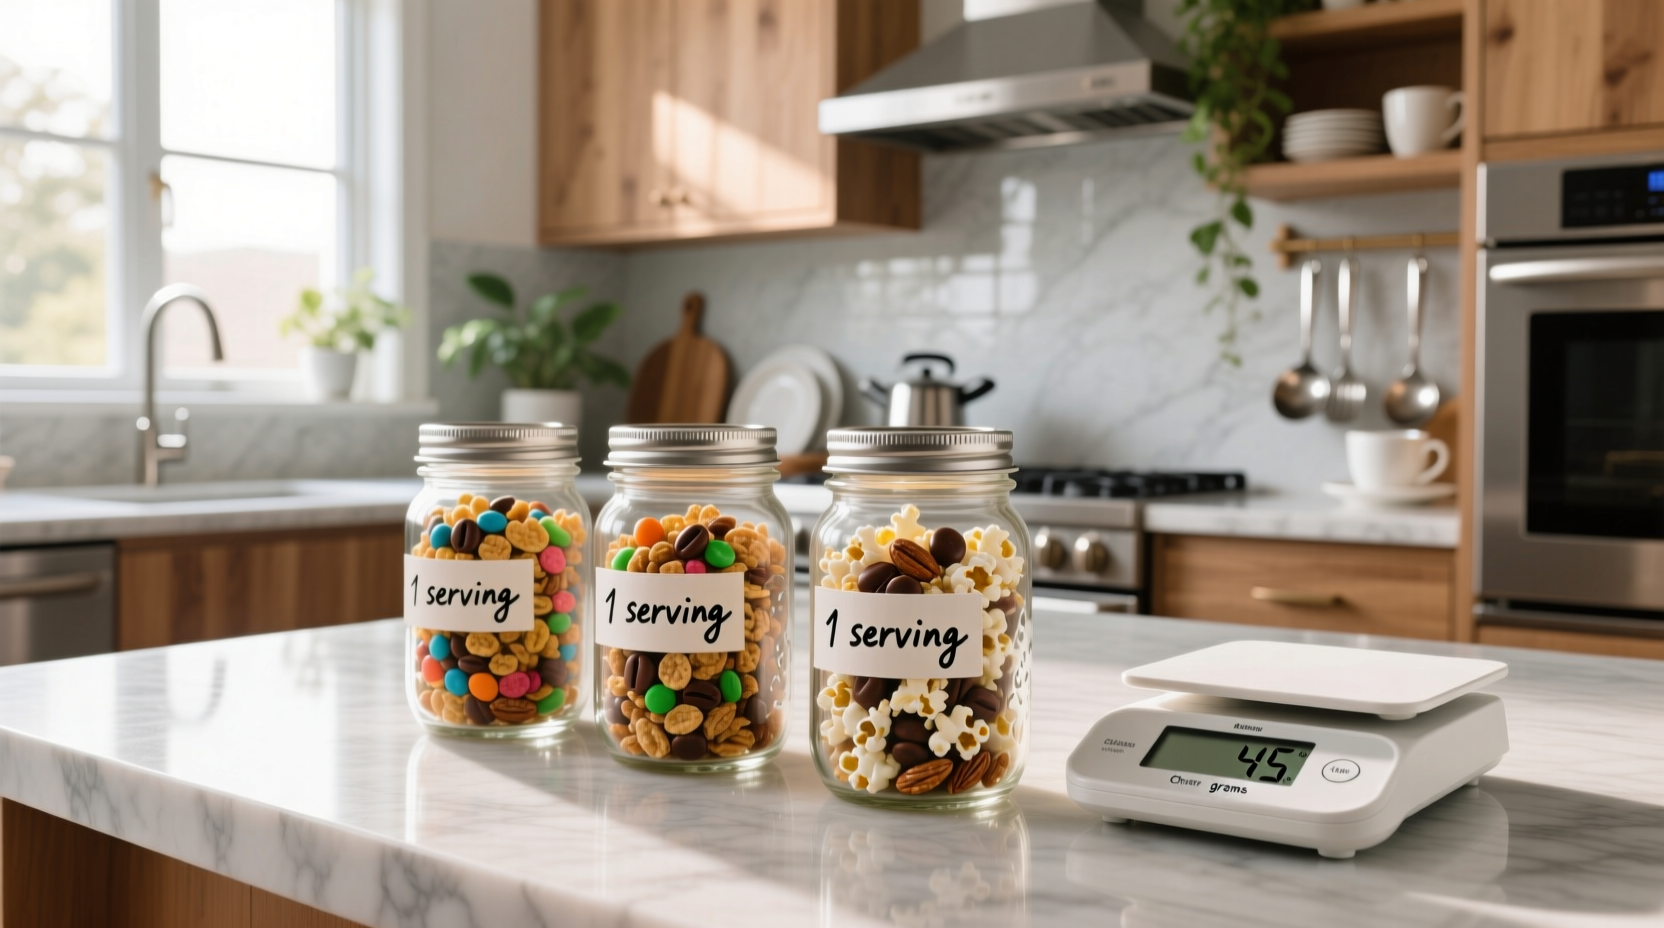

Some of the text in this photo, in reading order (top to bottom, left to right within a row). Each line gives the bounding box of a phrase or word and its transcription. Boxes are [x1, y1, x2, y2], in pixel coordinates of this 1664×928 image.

[410, 575, 521, 624] 1 serving
[605, 588, 733, 645] 1 serving
[825, 608, 969, 670] 1 serving
[1208, 782, 1248, 794] grams
[1237, 744, 1295, 783] 45
